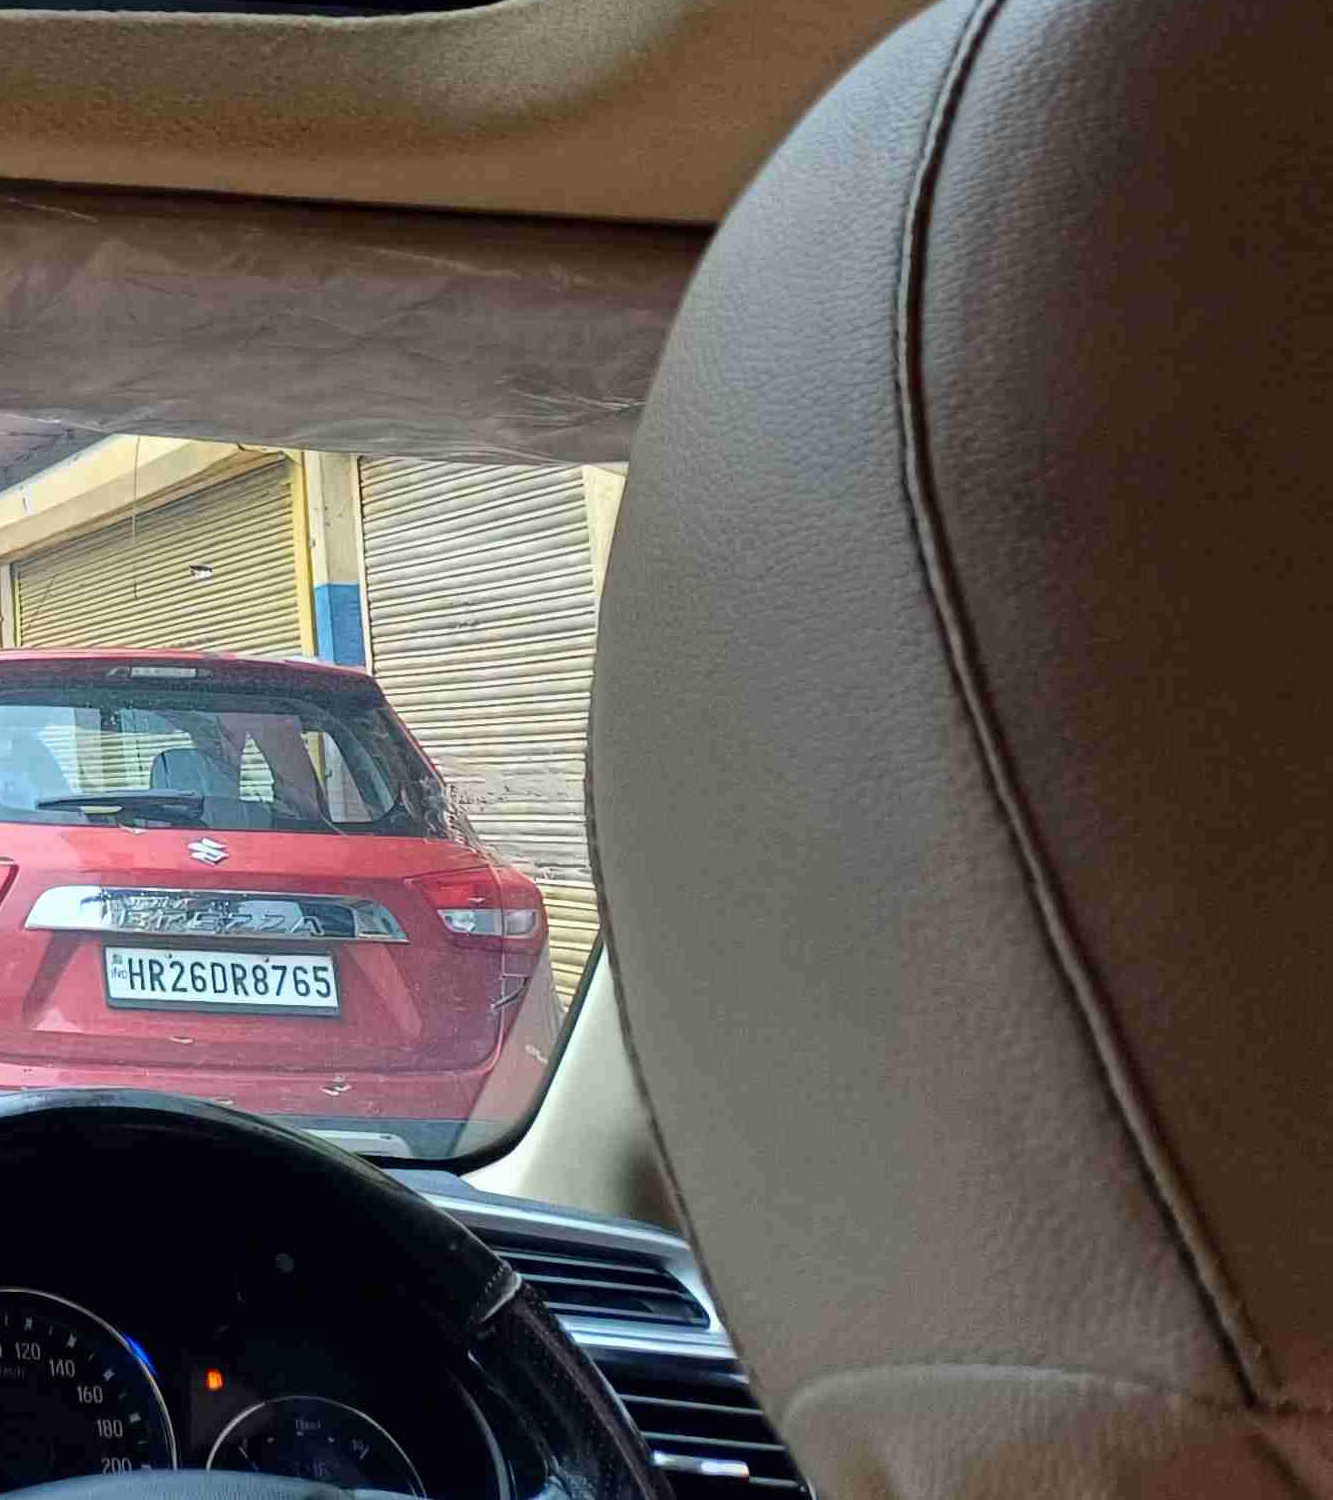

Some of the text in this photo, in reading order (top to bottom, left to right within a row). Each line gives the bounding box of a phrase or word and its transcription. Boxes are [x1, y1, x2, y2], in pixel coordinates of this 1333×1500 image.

[126, 957, 332, 999] HR26DR8765
[15, 1342, 41, 1361] 120
[49, 1359, 75, 1379] 140
[77, 1385, 103, 1405] 160
[97, 1419, 123, 1438] 180
